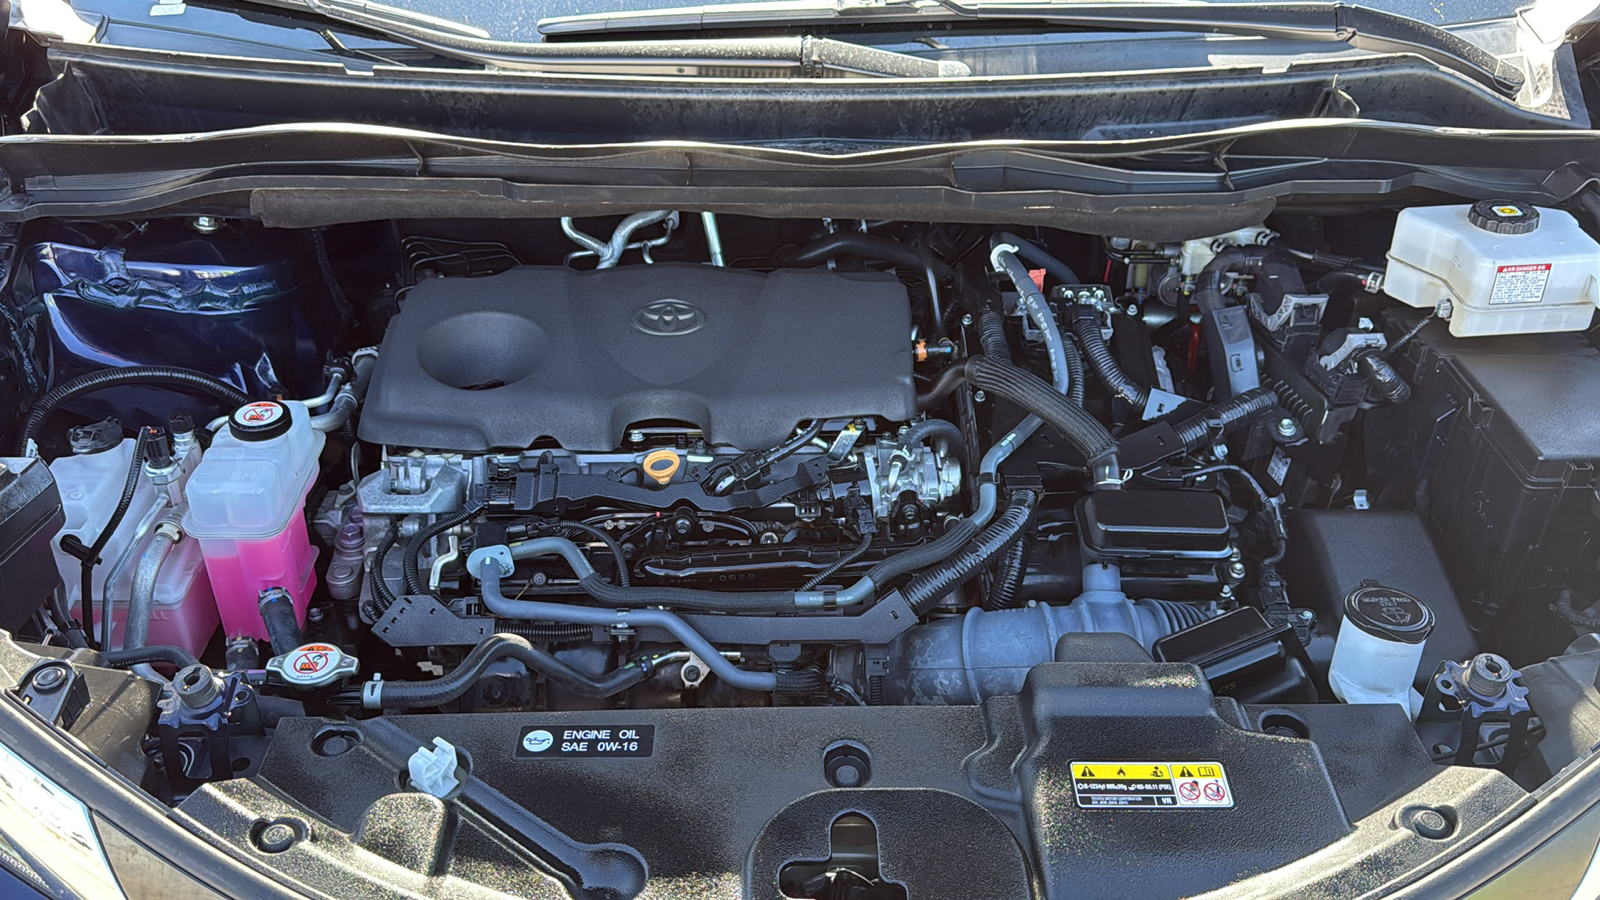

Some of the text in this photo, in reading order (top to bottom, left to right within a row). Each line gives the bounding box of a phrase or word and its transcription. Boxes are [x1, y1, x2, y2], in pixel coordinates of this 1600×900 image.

[563, 729, 640, 740] ENGINE OIL
[560, 741, 638, 752] SAE 0W-16
